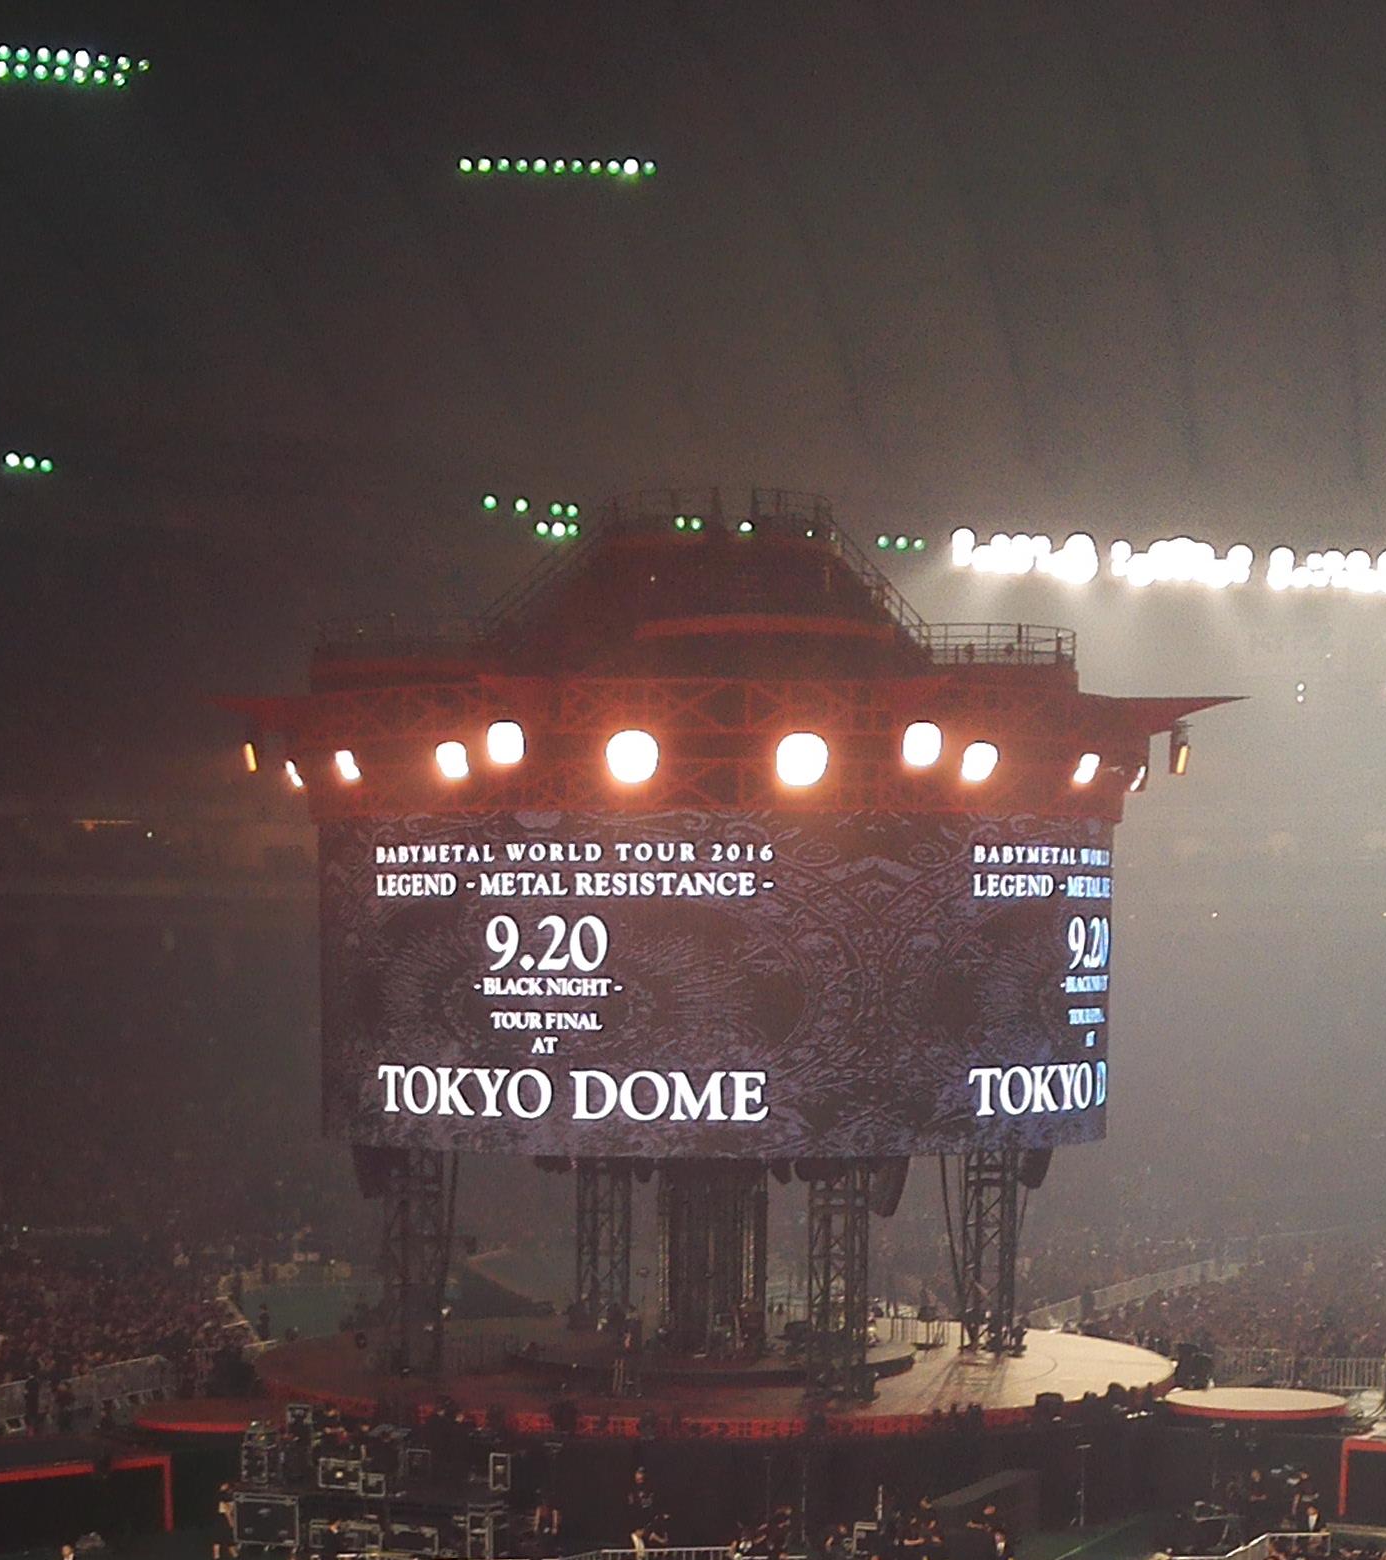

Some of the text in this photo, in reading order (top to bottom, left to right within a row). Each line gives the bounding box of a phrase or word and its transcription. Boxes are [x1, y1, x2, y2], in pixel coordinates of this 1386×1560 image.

[376, 843, 774, 863] BABYMETAL WORLD TOUR 2016
[974, 845, 1076, 865] BABYMETAL
[376, 873, 457, 897] LEGEND
[973, 873, 1054, 897] LEGEND
[485, 915, 609, 971] 9.20
[490, 1011, 603, 1030] TOUR FINAL
[531, 1036, 558, 1054] AT
[378, 1065, 769, 1121] TOKYO DOME
[968, 1061, 1093, 1116] TOKYO
